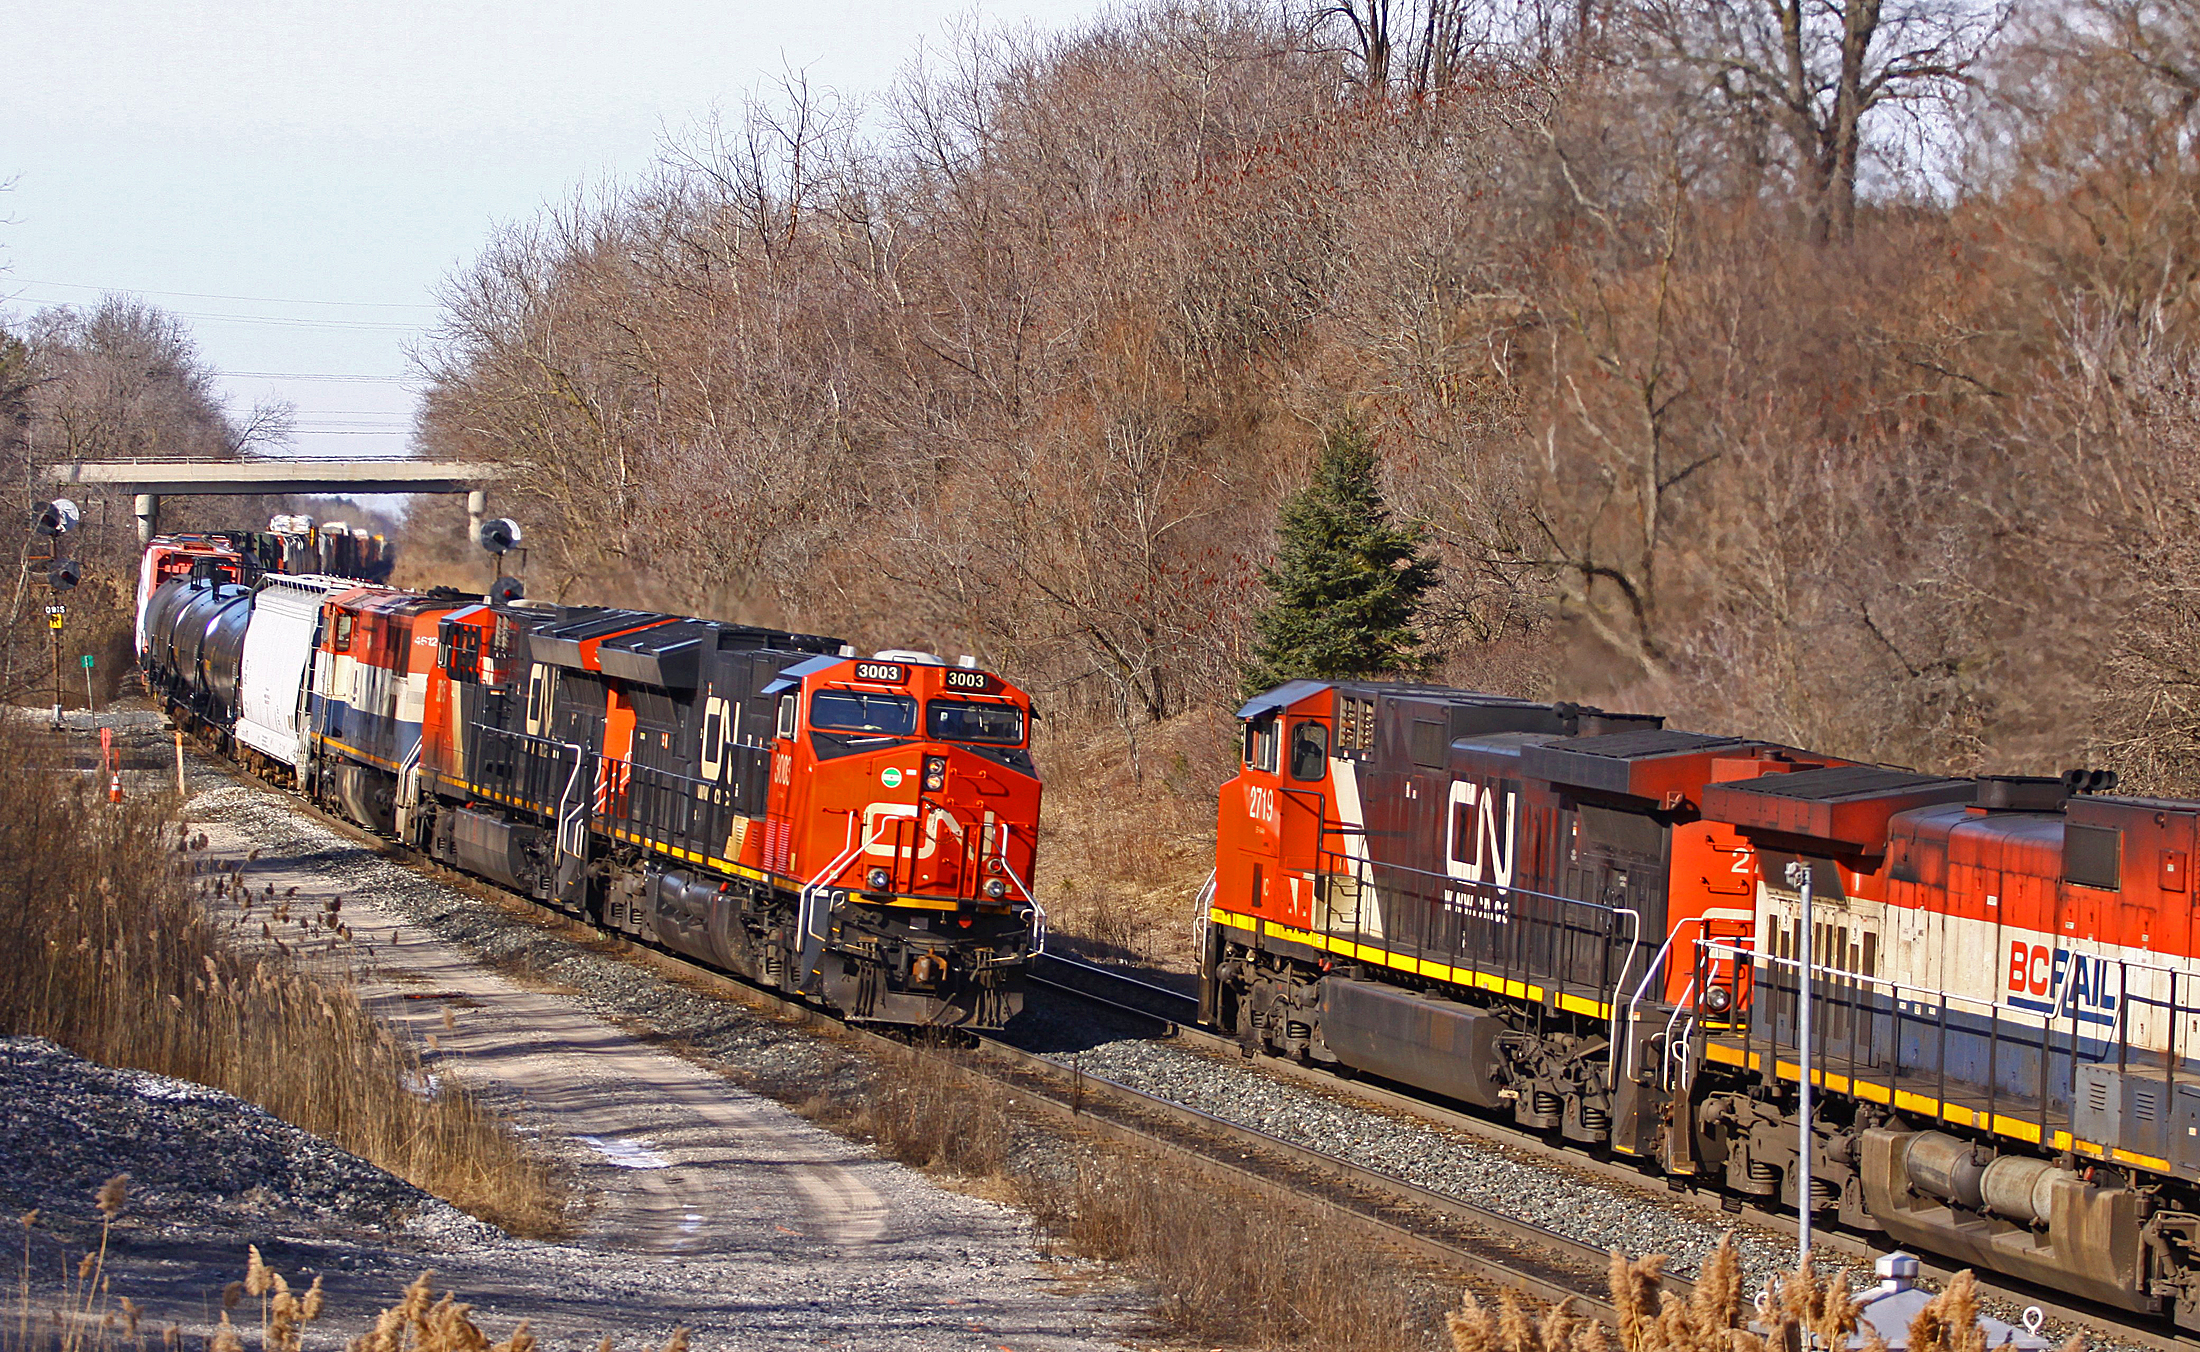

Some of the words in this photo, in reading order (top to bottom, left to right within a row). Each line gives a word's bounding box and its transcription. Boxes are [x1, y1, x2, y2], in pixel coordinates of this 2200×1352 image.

[526, 663, 558, 738] CN
[859, 664, 898, 679] 3003
[948, 672, 985, 688] 3003
[701, 697, 740, 785] CN
[862, 802, 995, 862] CN
[1249, 785, 1273, 822] 2719
[1447, 779, 1516, 895] CN
